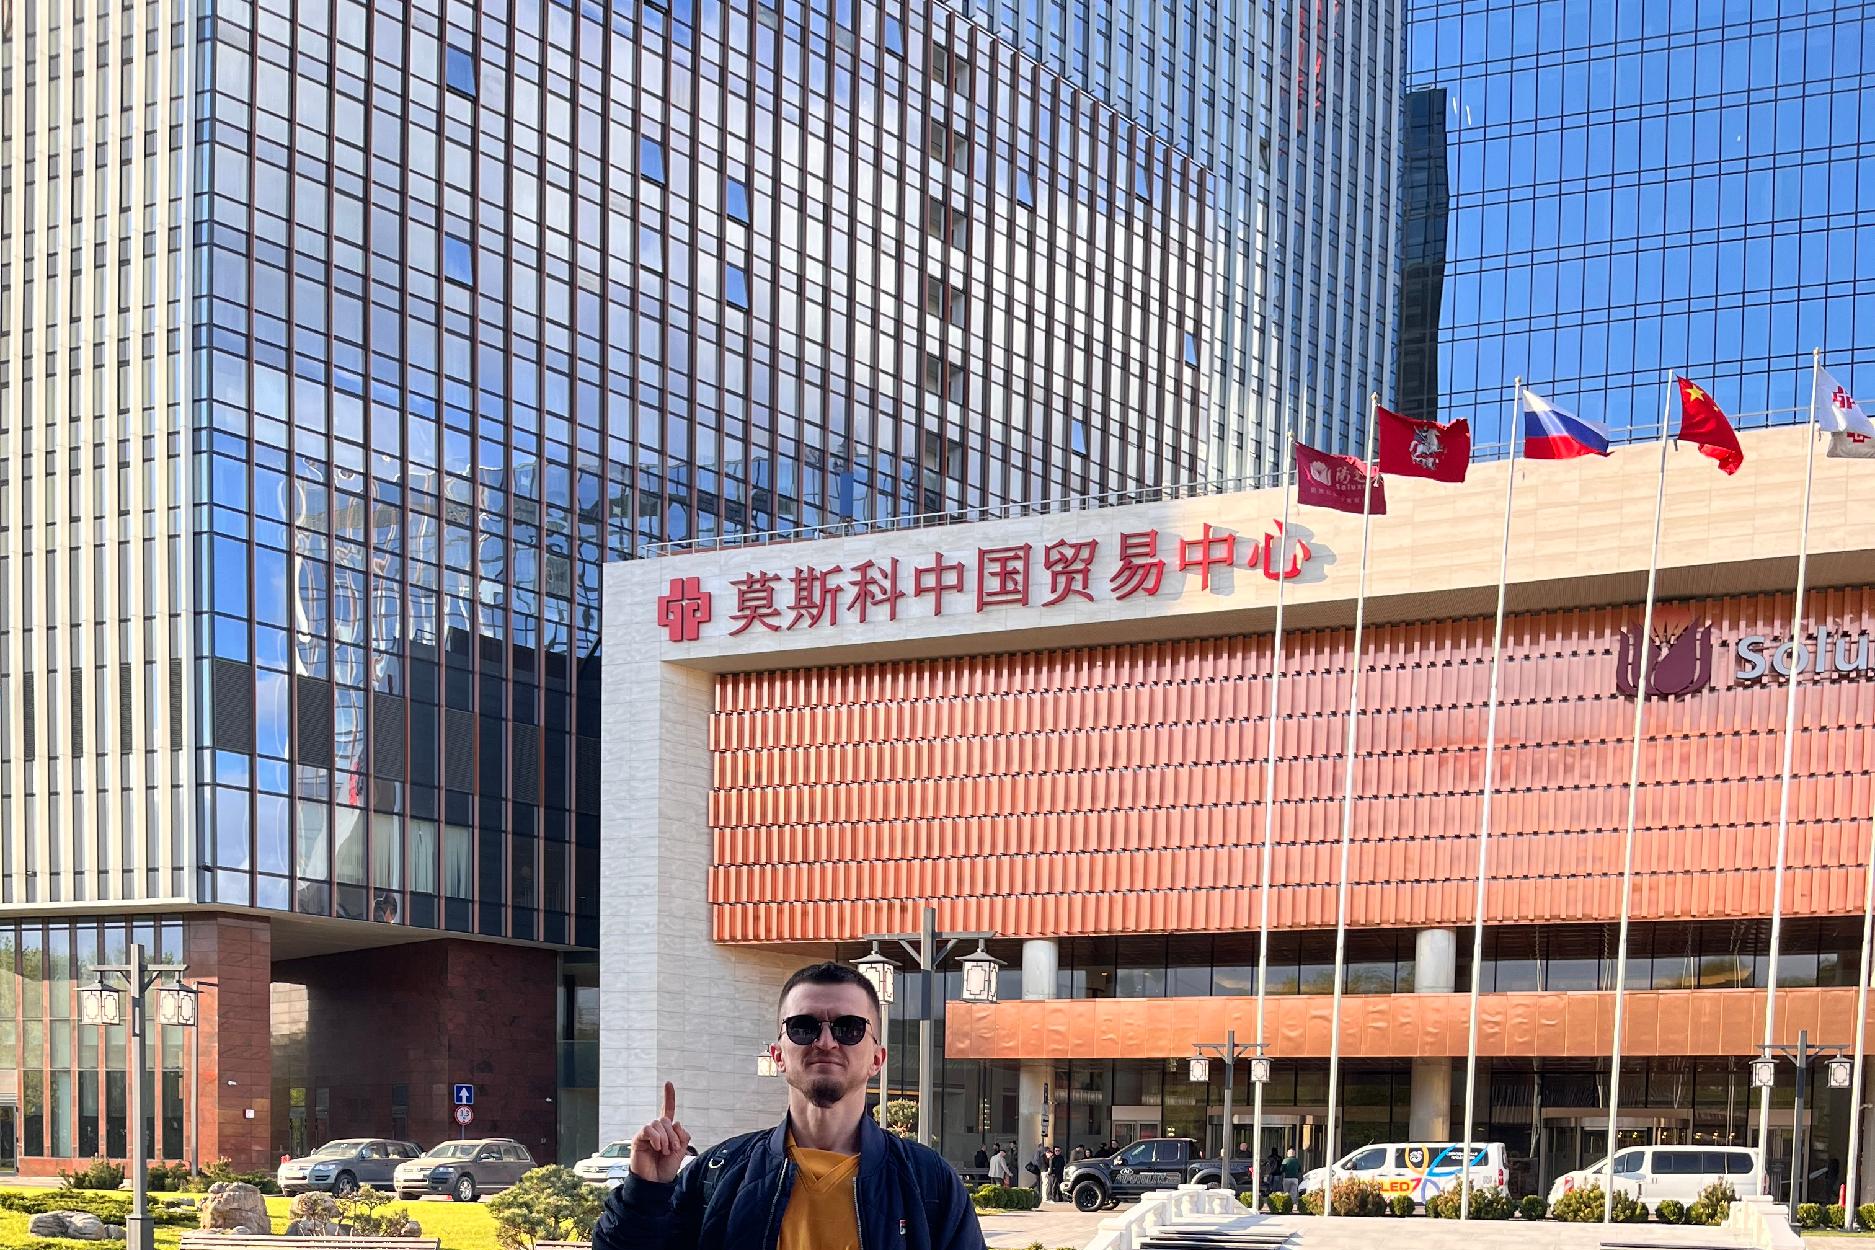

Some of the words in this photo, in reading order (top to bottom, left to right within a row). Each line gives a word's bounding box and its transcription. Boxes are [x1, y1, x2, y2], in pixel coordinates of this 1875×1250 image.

[728, 518, 1312, 636] 莫斯科中国贸易中心
